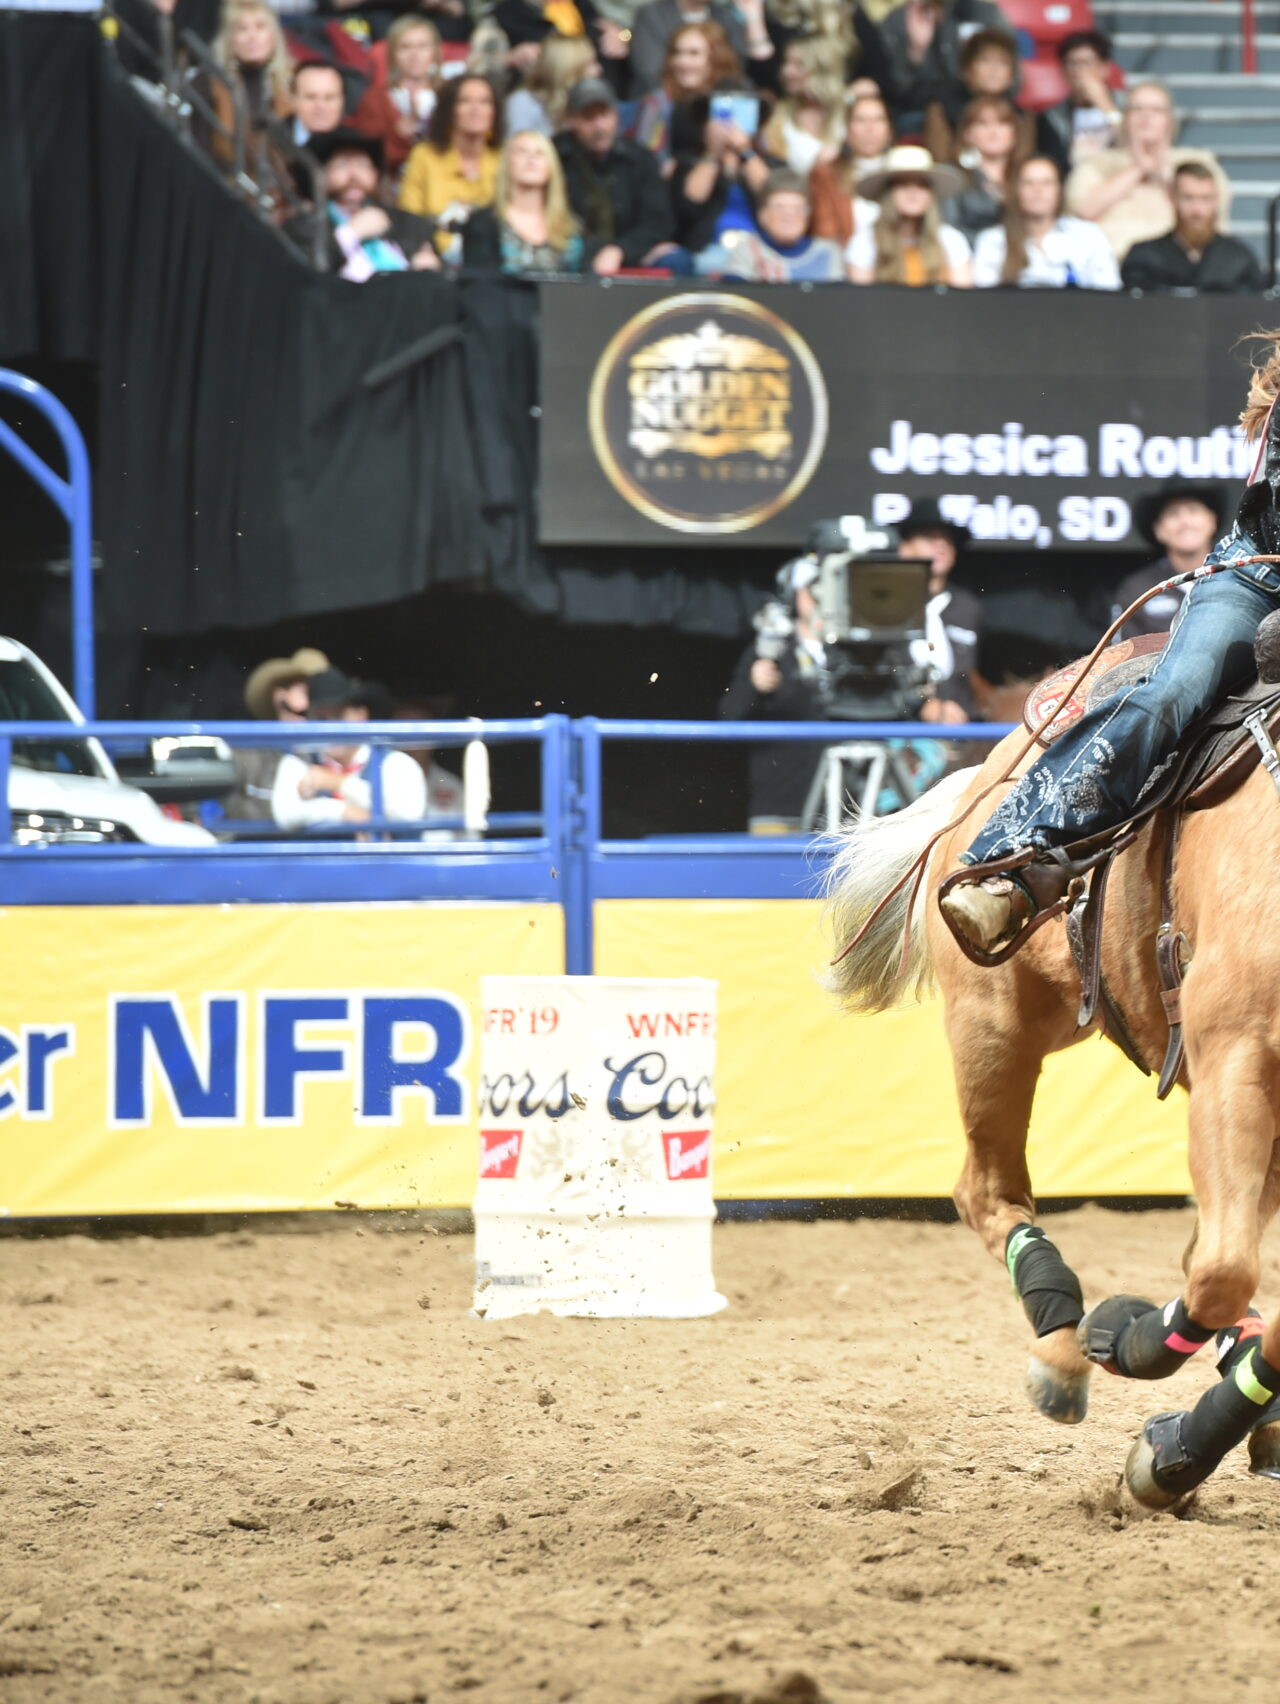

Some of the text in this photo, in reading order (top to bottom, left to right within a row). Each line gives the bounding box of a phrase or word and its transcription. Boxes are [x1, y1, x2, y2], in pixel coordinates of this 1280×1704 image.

[870, 420, 1262, 479] Jessica Routi
[872, 493, 1132, 549] Bffalo, SD
[111, 995, 468, 1122] NFR
